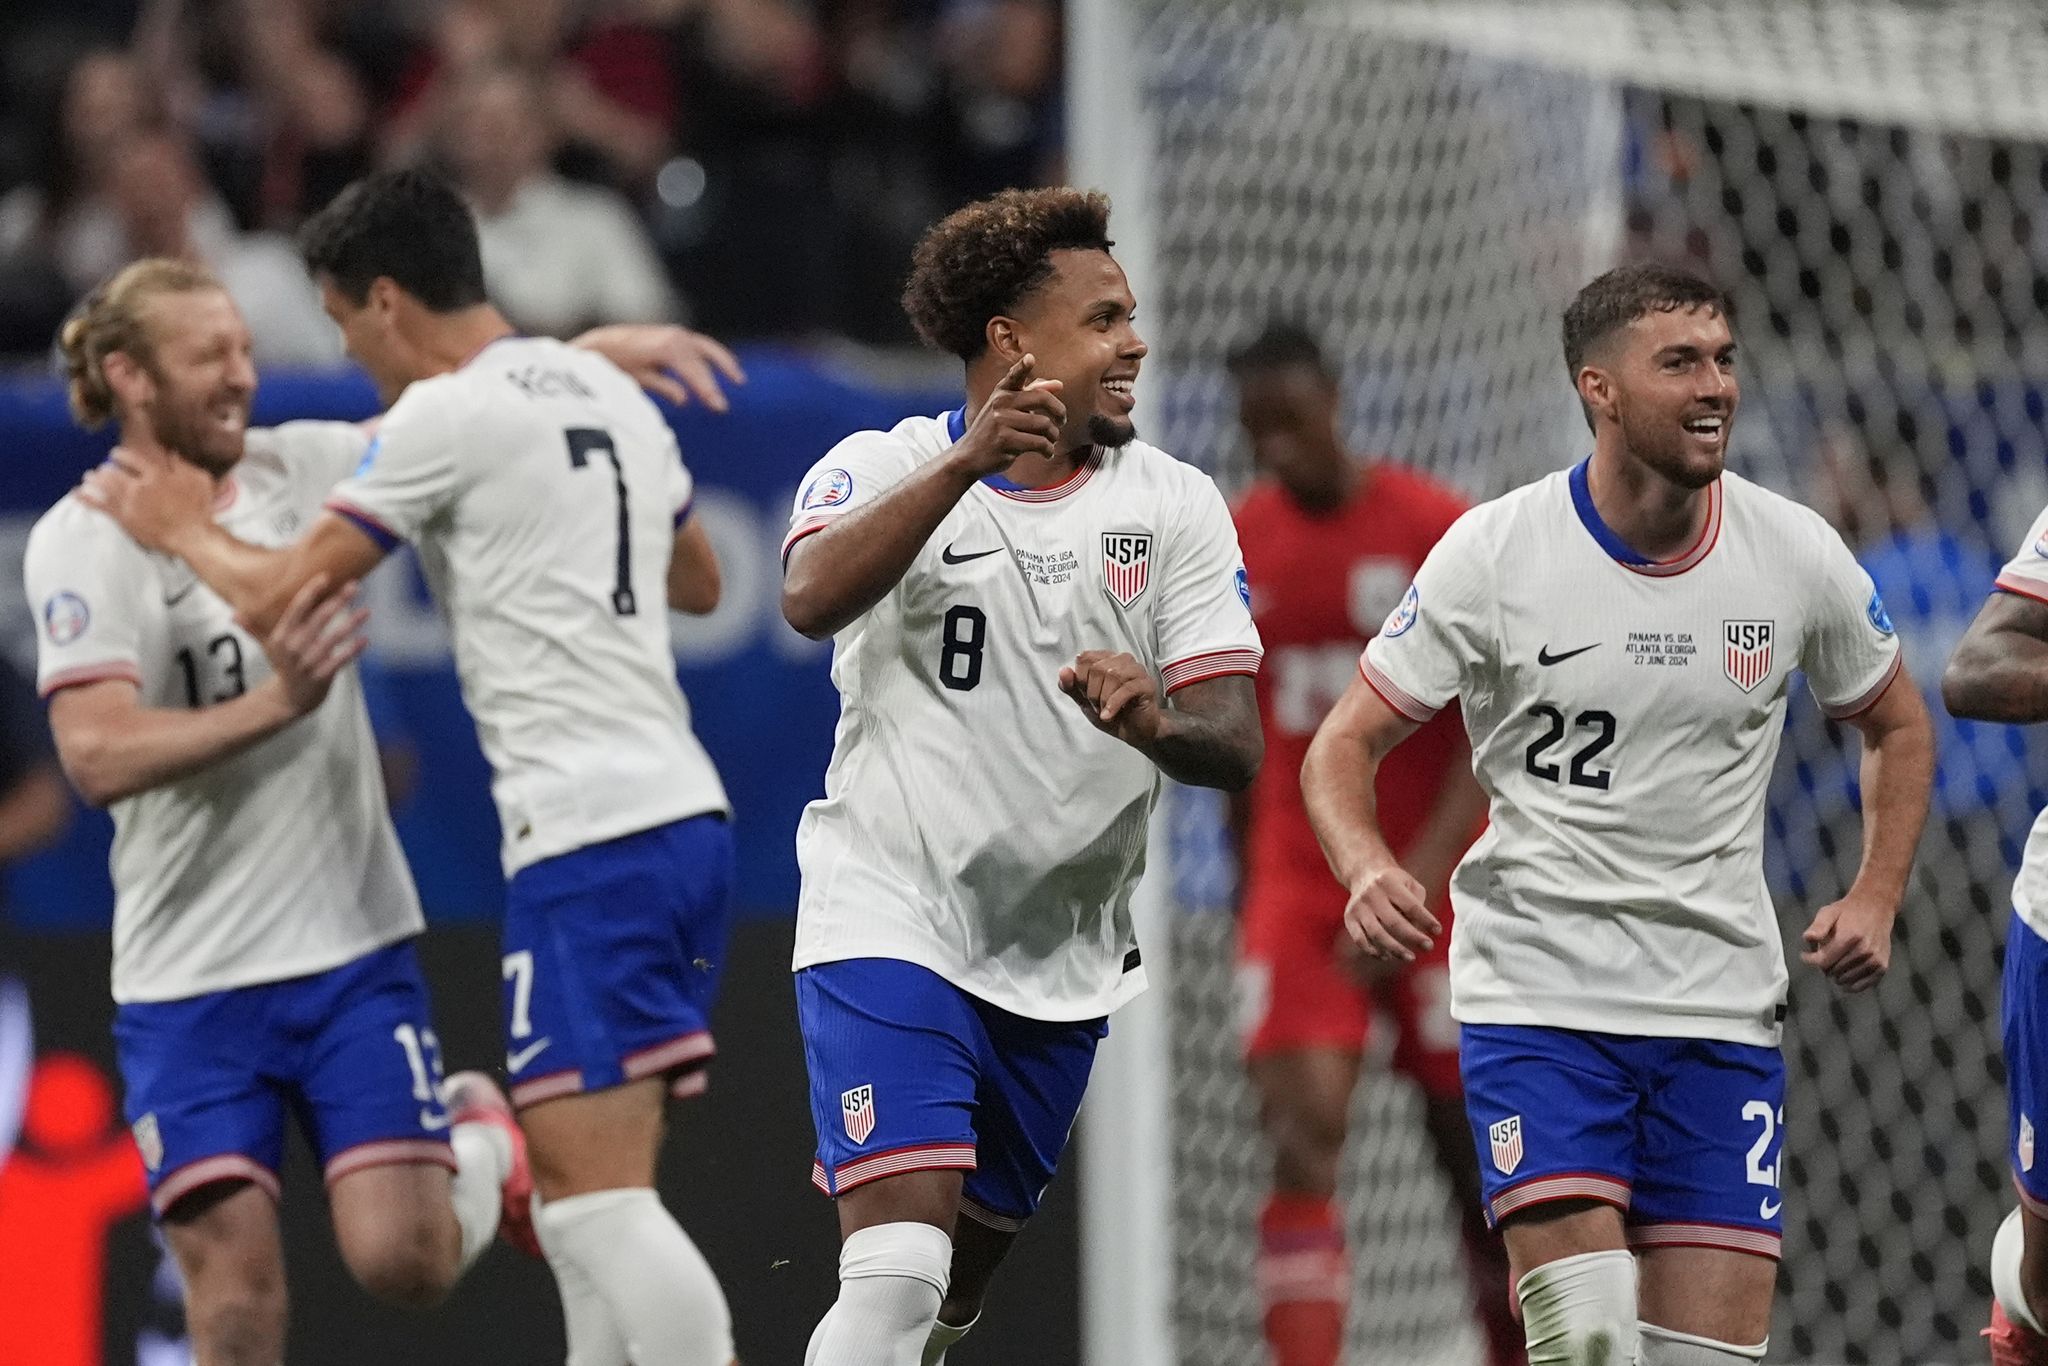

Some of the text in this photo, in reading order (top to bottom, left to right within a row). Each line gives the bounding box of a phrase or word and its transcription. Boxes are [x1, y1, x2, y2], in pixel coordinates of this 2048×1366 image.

[564, 427, 637, 617] 7
[1059, 550, 1074, 561] USA
[1105, 537, 1148, 565] USA
[1048, 560, 1079, 573] GEORGIA
[1052, 572, 1071, 584] 2024
[939, 604, 987, 692] 8
[1628, 632, 1661, 642] PANAMA
[1677, 633, 1693, 644] USA
[1664, 644, 1697, 655] GEORGIA
[1727, 625, 1770, 650] USA
[176, 632, 246, 711] 13
[1634, 655, 1688, 667] 27 JUNE 2024
[1525, 703, 1617, 791] 22
[502, 949, 534, 1040] 7
[843, 1087, 870, 1113] USA
[1491, 1119, 1518, 1144] USA
